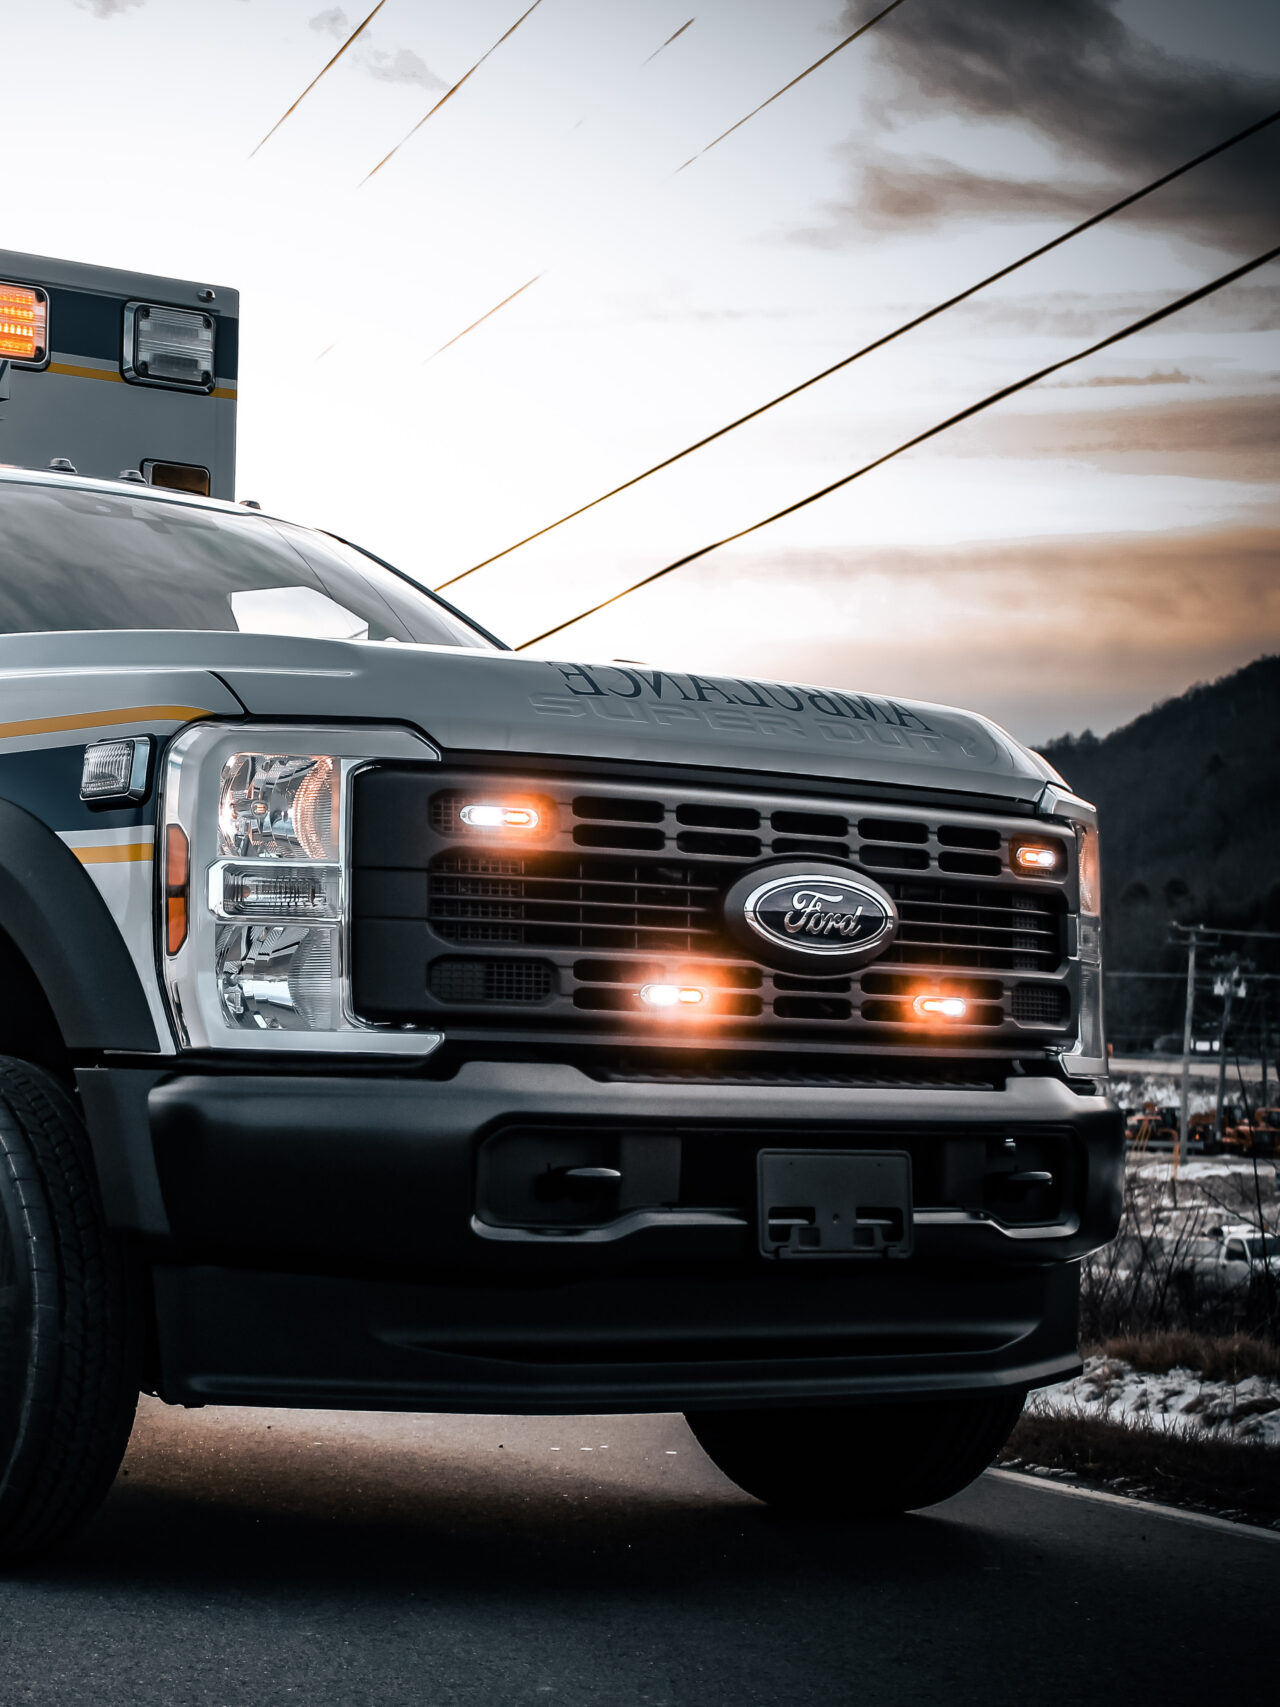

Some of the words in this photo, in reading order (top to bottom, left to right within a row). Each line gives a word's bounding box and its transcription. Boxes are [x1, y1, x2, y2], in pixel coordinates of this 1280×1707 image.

[528, 691, 808, 739] SUPER
[815, 717, 977, 758] DUTY
[784, 890, 863, 937] Ford
